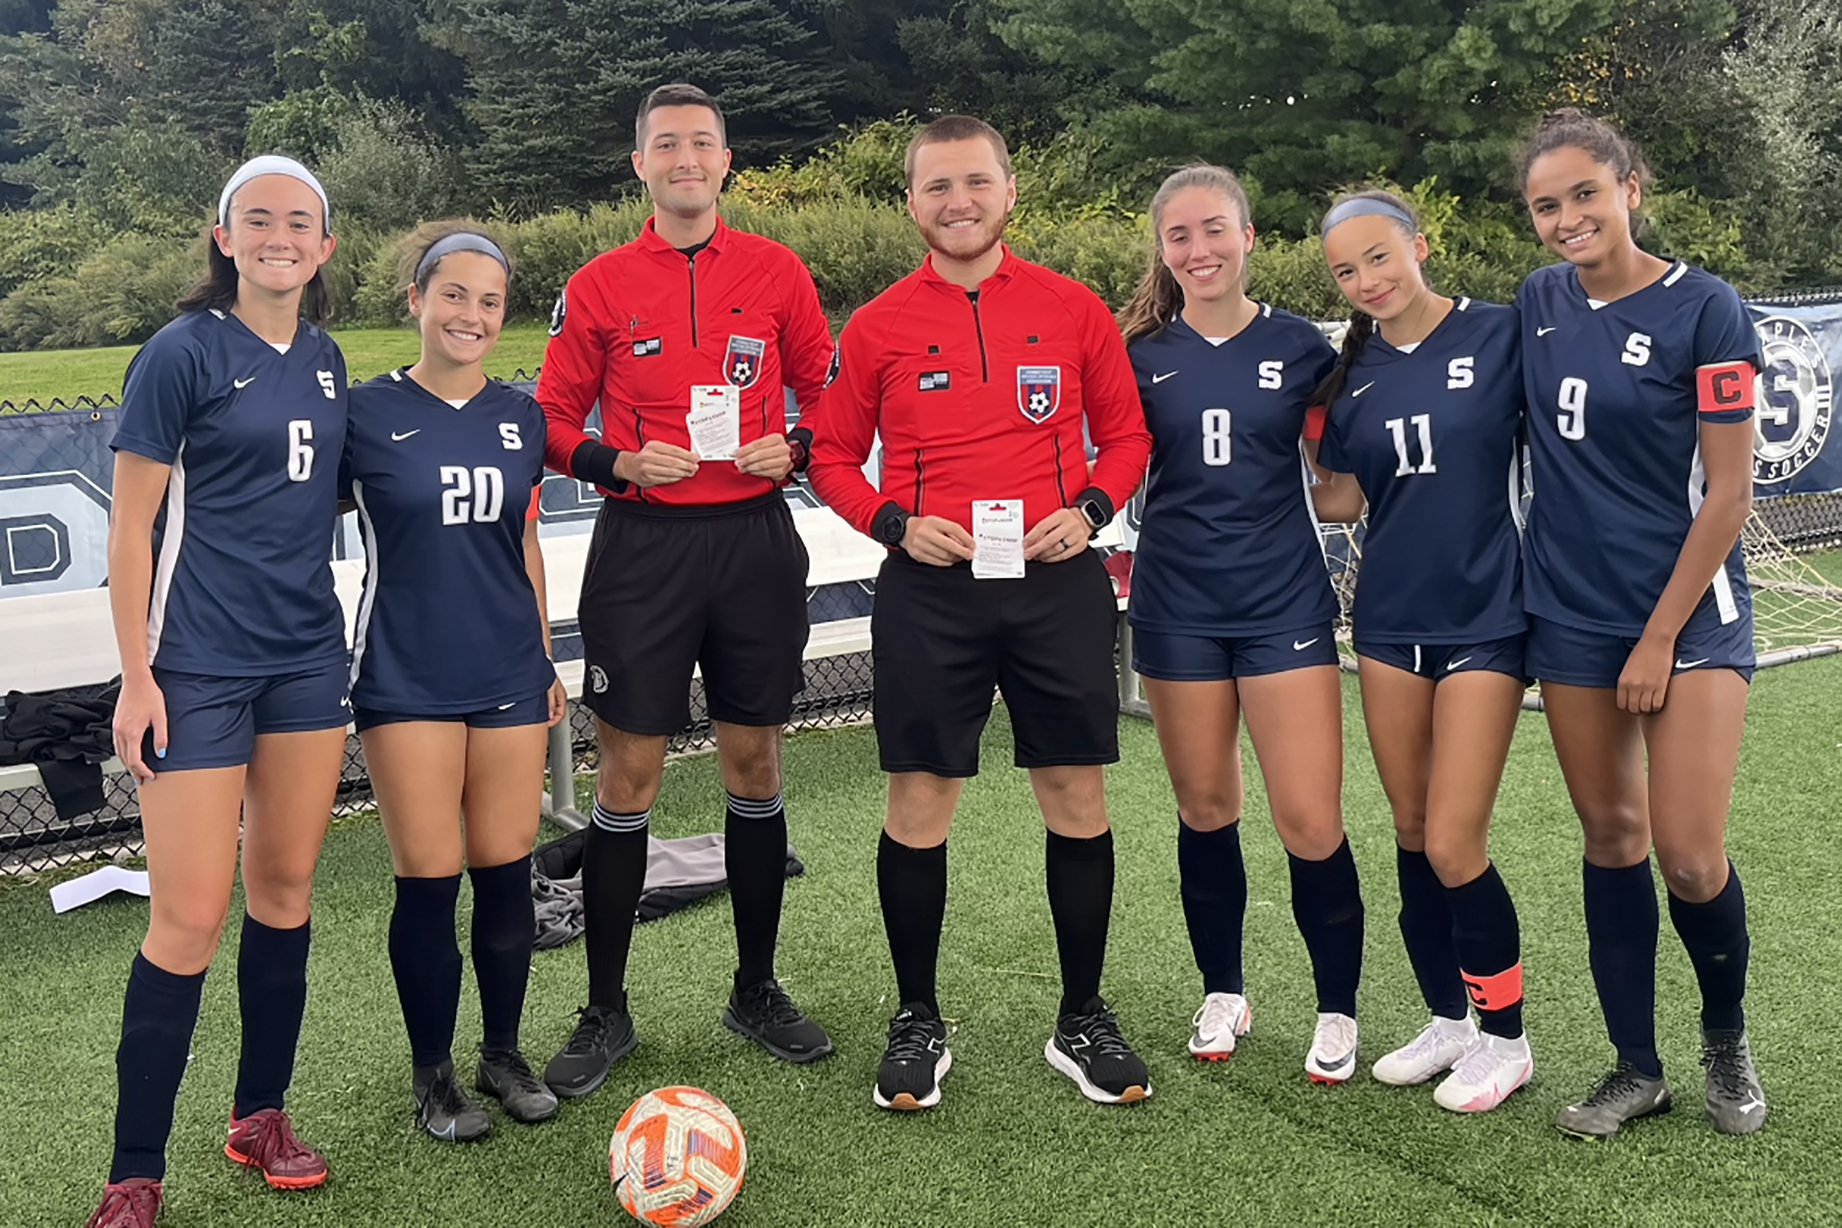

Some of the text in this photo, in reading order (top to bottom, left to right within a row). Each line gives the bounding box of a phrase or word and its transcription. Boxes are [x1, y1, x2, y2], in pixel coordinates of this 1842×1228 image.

[1621, 332, 1651, 367] S
[316, 370, 336, 400] S
[1258, 360, 1284, 390] S
[1447, 356, 1475, 390] S
[1712, 371, 1742, 404] C
[1557, 377, 1588, 441] 9
[287, 420, 314, 482] 6
[498, 423, 523, 450] S
[1202, 408, 1232, 466] 8
[1385, 413, 1437, 477] 11
[1767, 414, 1829, 479] SOCCER
[440, 466, 504, 525] 20
